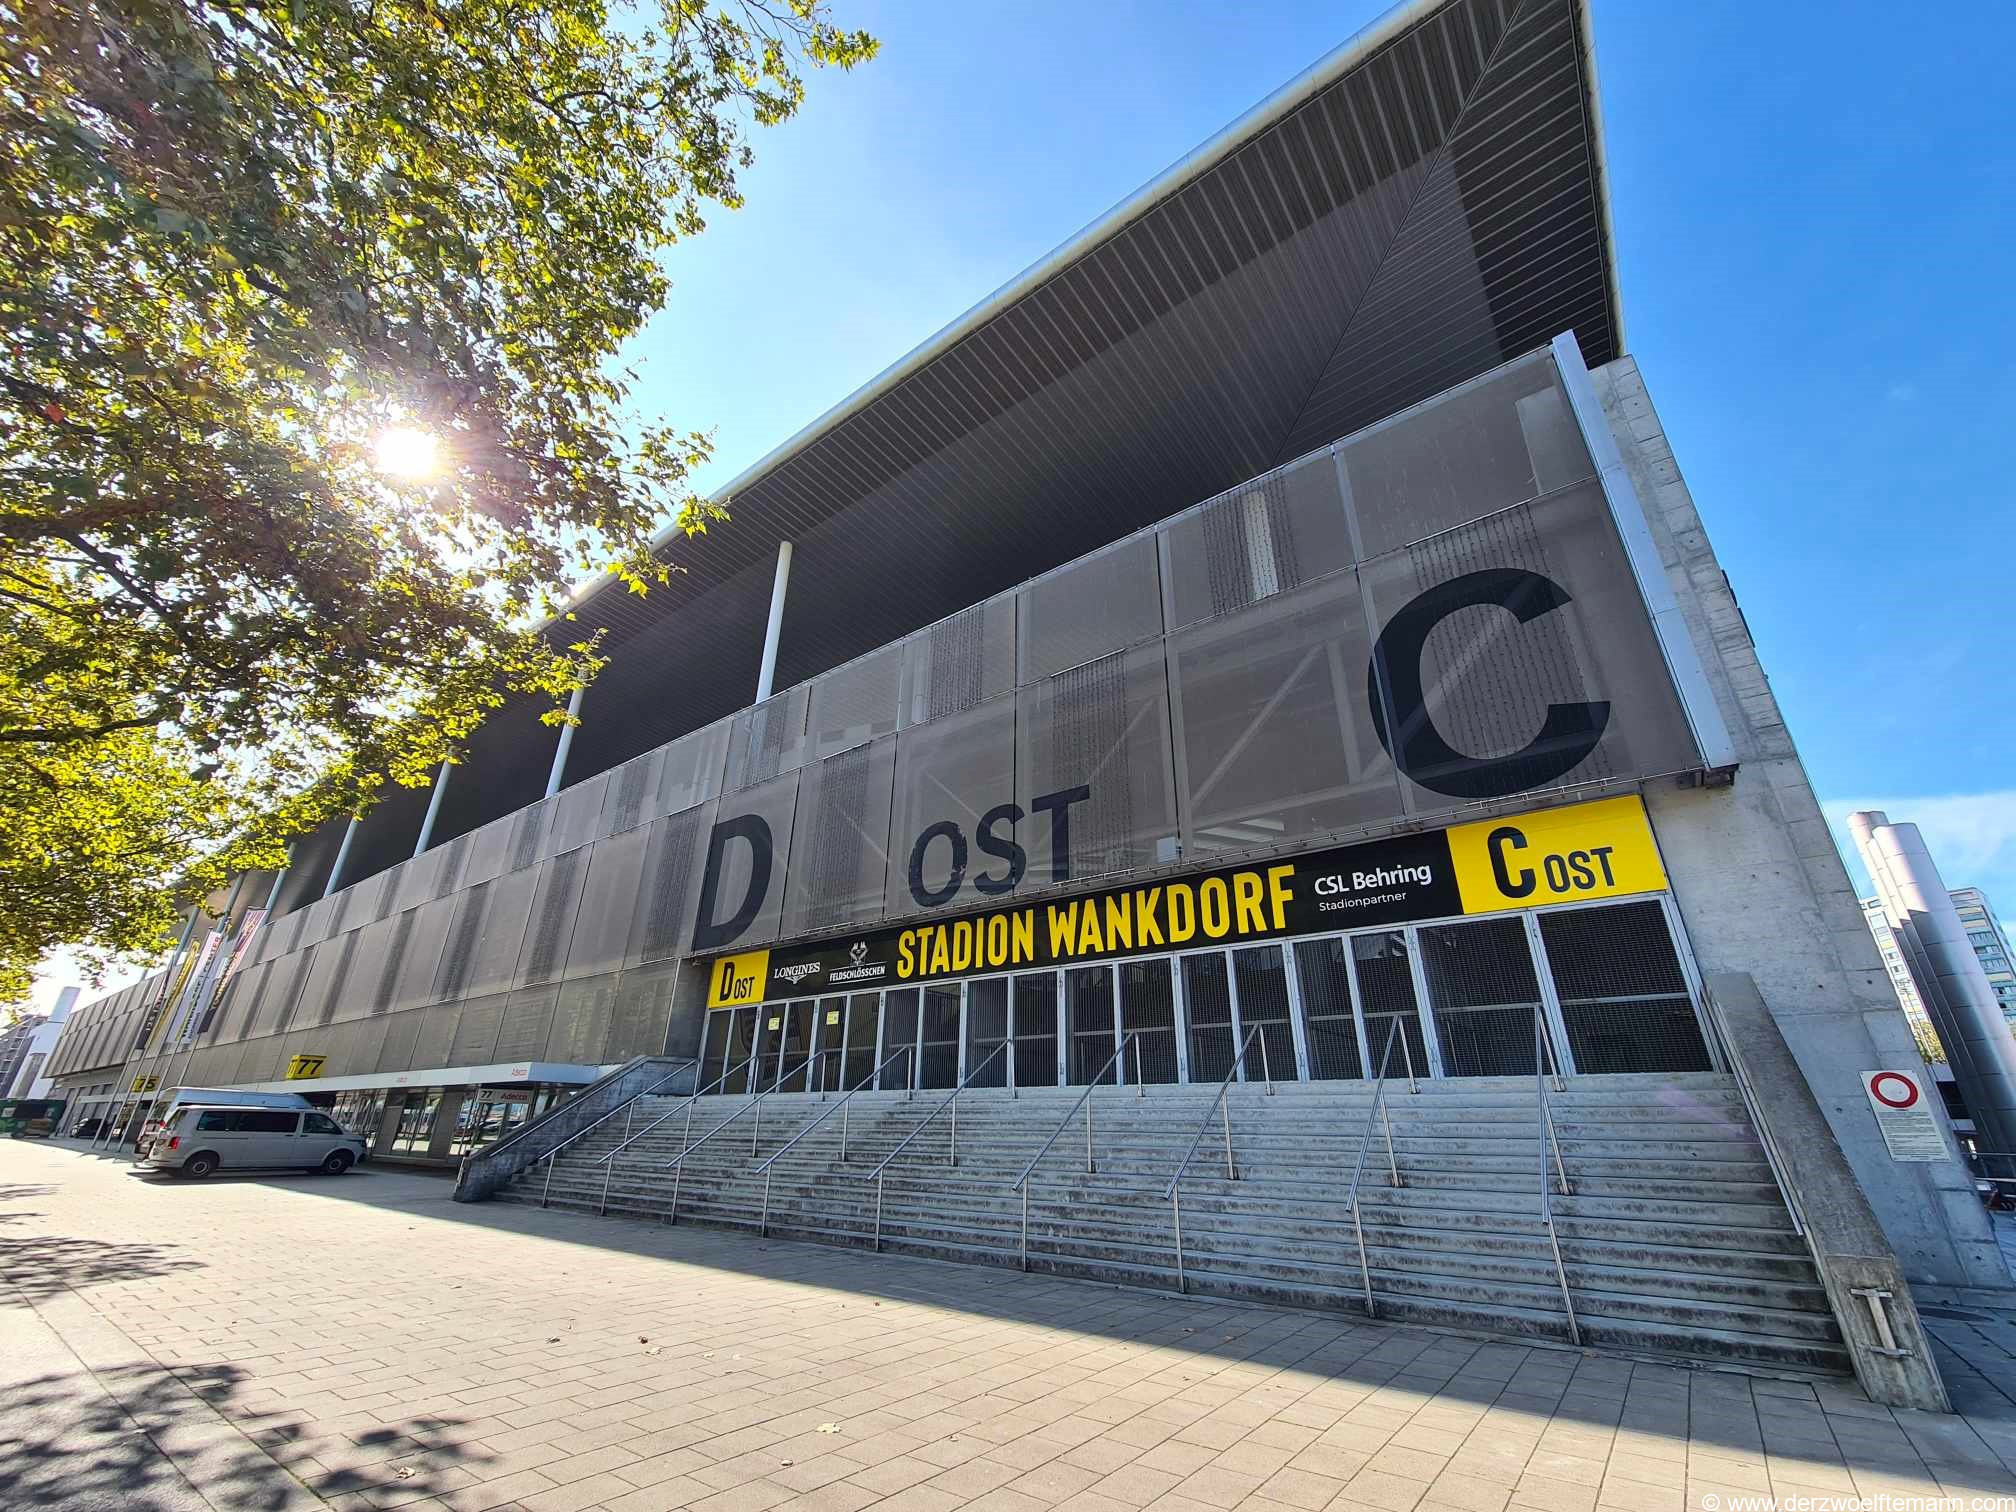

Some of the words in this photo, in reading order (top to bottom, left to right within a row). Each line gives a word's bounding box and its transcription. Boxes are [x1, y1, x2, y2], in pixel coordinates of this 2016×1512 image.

[1369, 568, 1610, 796] C
[692, 814, 773, 952] D
[908, 785, 1090, 908] OST
[1487, 826, 1536, 899] C
[1544, 846, 1616, 893] OST
[1314, 875, 1350, 895] CSL
[1352, 864, 1432, 885] Behring
[1319, 892, 1407, 911] Stadionpartner
[897, 909, 1034, 979] STADION
[1046, 863, 1296, 958] WANKDORF
[719, 962, 735, 1001] D
[734, 975, 756, 999] OST
[774, 962, 820, 979] LONGINES
[829, 965, 886, 982] FELDSCHLÖSSCHEN
[298, 1059, 324, 1075] 77
[139, 1078, 156, 1089] 75
